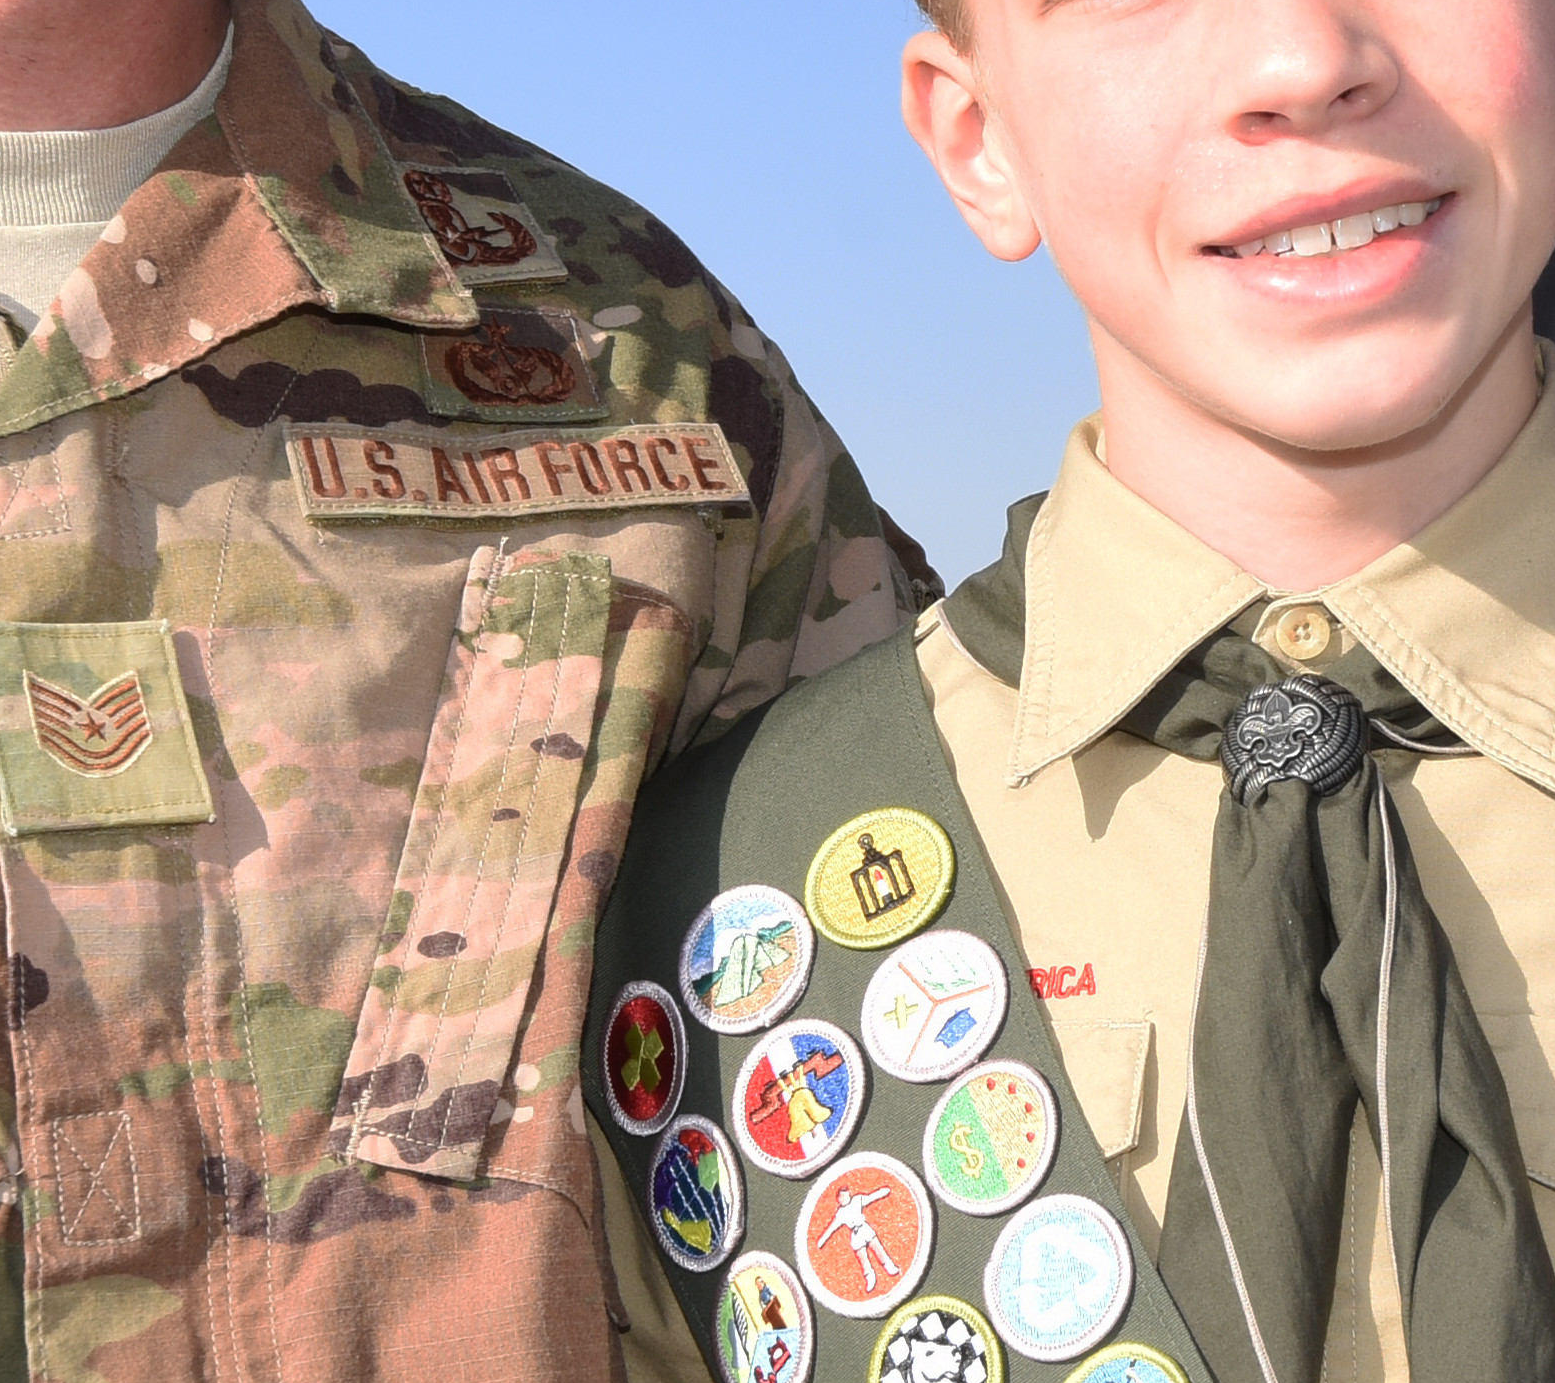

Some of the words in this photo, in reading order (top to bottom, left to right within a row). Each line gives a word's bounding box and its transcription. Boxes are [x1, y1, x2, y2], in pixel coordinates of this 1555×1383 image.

[302, 437, 426, 502] U.S.
[431, 446, 532, 505] AIR
[531, 437, 727, 496] FORCE
[1027, 962, 1097, 999] RICA
